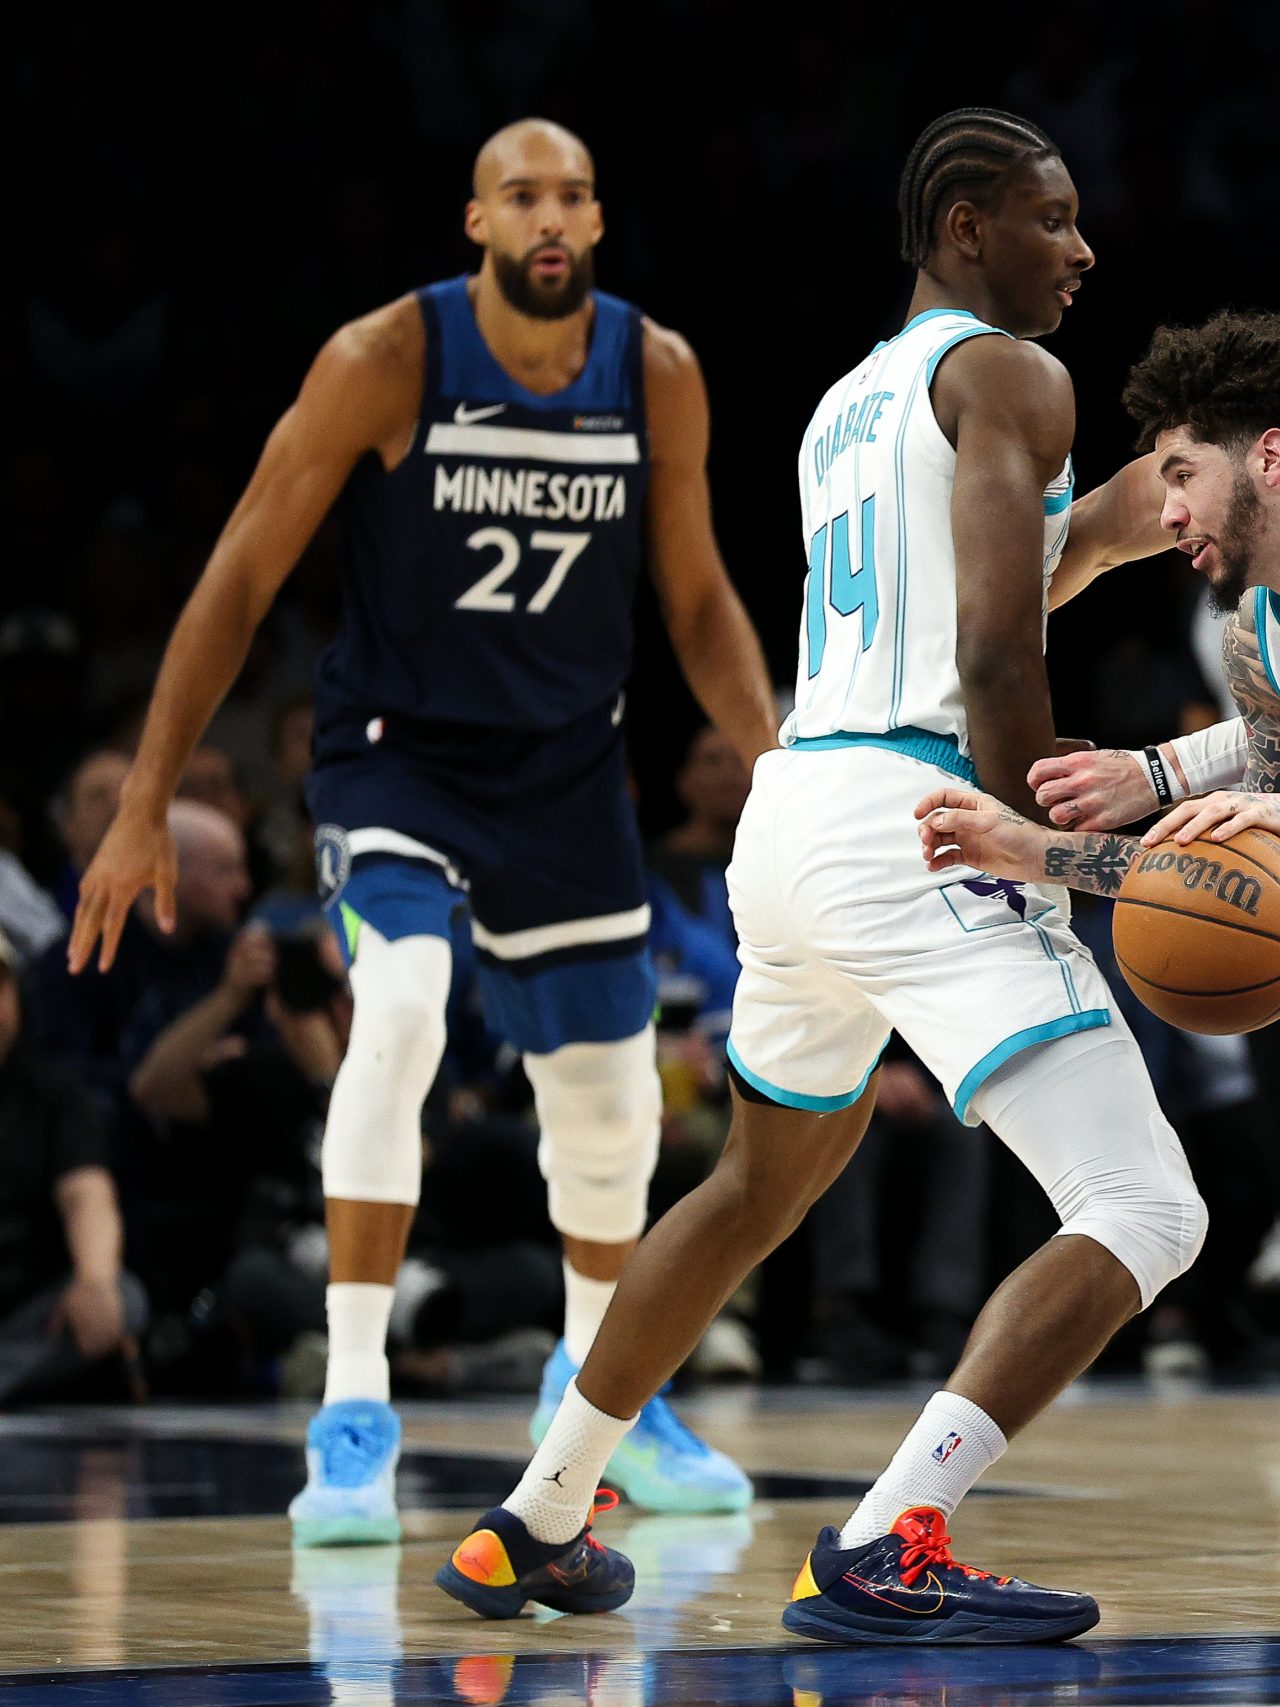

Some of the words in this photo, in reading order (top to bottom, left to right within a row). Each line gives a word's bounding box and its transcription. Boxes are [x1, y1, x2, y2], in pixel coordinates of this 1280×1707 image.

[814, 391, 895, 488] DIABATE
[433, 462, 626, 522] MINNESOTA
[454, 526, 593, 614] 27
[806, 492, 880, 681] 14
[1150, 759, 1167, 796] Believe
[1137, 849, 1263, 917] Wilson
